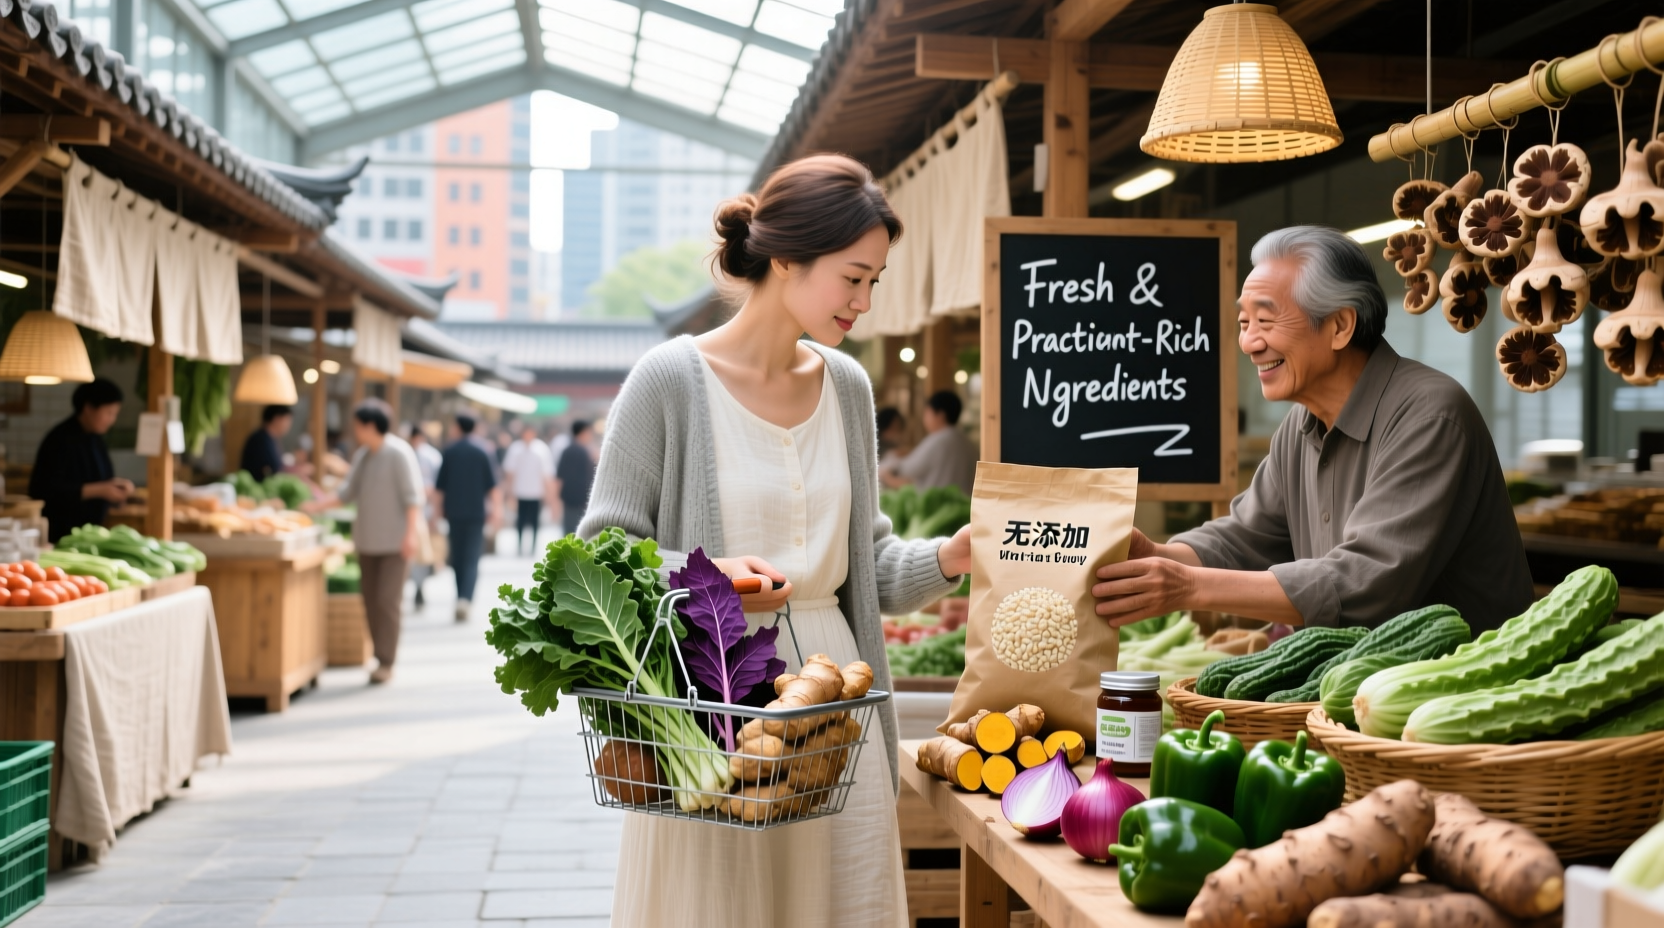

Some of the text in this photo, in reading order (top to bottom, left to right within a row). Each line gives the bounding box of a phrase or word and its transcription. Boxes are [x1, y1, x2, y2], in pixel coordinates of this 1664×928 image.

[1020, 258, 1164, 308] Fresh &
[1022, 362, 1187, 428] Ngredients
[1002, 520, 1090, 549] 无添加
